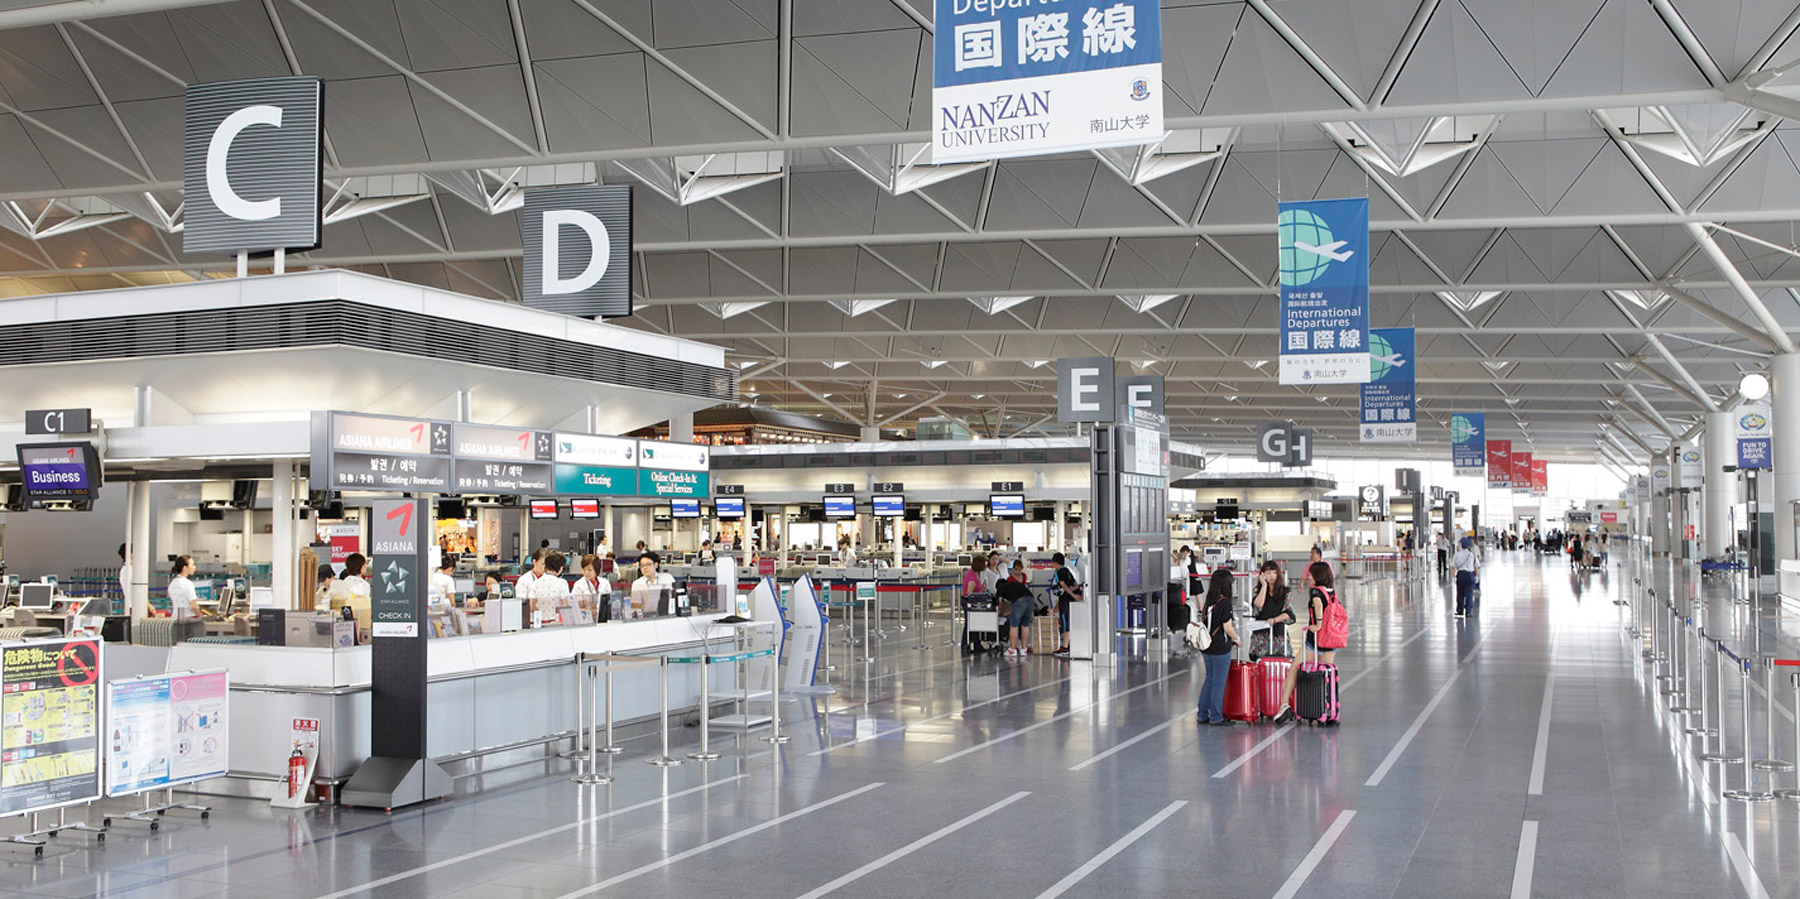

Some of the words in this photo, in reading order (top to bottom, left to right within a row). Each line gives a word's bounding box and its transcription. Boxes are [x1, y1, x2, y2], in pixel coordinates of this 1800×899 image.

[954, 4, 1137, 72] 国際線
[940, 90, 1051, 131] NANZAN
[1089, 114, 1150, 134] 南山大学
[941, 122, 1050, 149] UNIVERSITY
[206, 104, 283, 221] C
[542, 209, 611, 295] D
[1287, 306, 1361, 319] International
[1287, 318, 1350, 330] Departures
[1287, 329, 1361, 350] 国際線
[1313, 369, 1347, 378] 南山大学
[1070, 367, 1100, 411] E
[1364, 393, 1411, 402] International
[44, 411, 64, 432] C1
[339, 434, 372, 447] ASIANA
[374, 437, 413, 450] AIRLINES
[460, 442, 487, 455] ASIANA
[488, 445, 520, 457] AIRLINES
[1262, 428, 1286, 456] G
[370, 458, 388, 471] 발권
[400, 460, 417, 472] 예약
[32, 469, 80, 483] Business
[583, 473, 612, 488] Ticketing
[725, 486, 735, 494] E4
[834, 484, 845, 493] E3
[882, 483, 894, 492] E2
[1001, 482, 1012, 491] E1
[376, 542, 414, 552] ASIANA
[378, 612, 402, 620] CHECK
[5, 648, 77, 665] 危険物について
